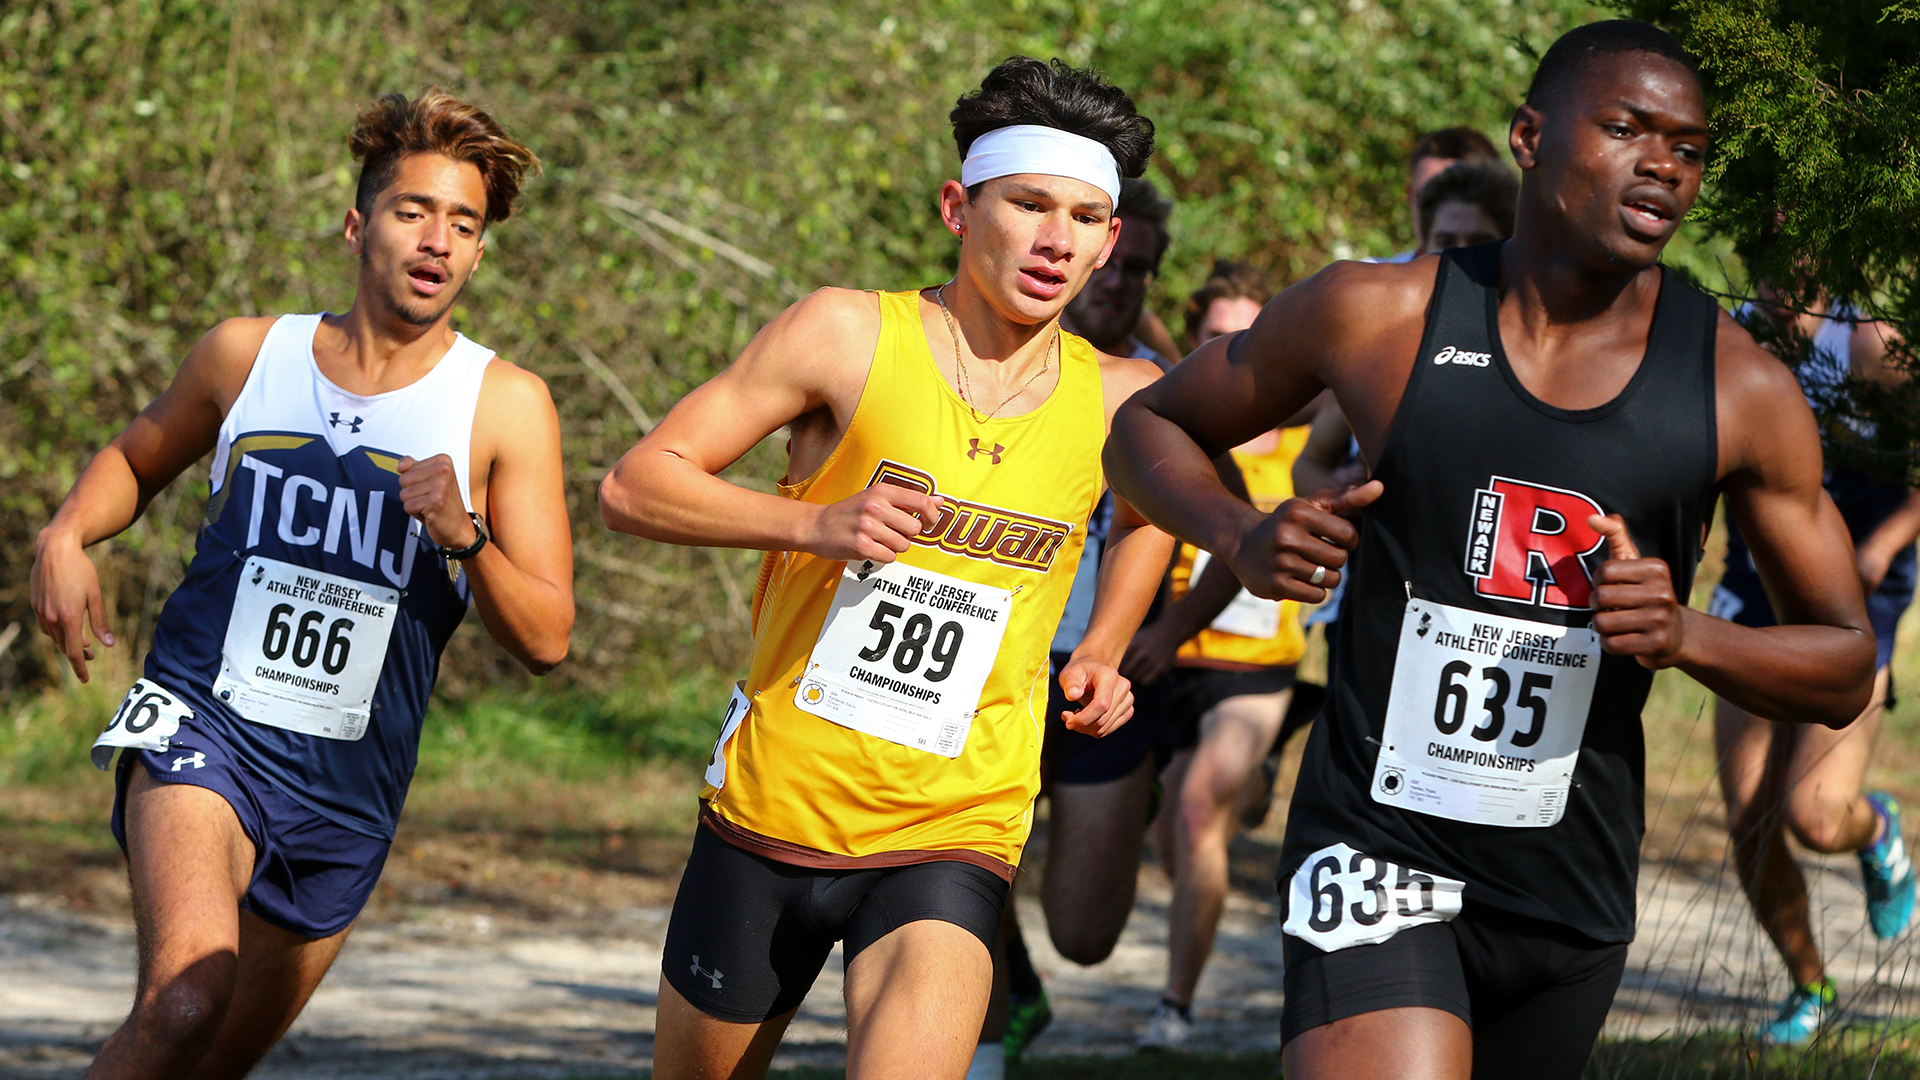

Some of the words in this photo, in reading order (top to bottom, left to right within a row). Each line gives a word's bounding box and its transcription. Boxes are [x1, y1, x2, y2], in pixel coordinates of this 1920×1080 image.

[1452, 349, 1491, 367] asics
[241, 453, 423, 589] TCNJ
[1469, 495, 1497, 574] NEWARK
[1474, 474, 1606, 611] R
[266, 580, 316, 602] ATHLETIC
[318, 593, 386, 618] CONFERENCE
[296, 575, 320, 591] NEW
[322, 582, 362, 601] JERSEY
[872, 578, 928, 604] ATHLETIC
[929, 595, 999, 622] CONFERENCE
[906, 575, 934, 593] NEW
[935, 584, 977, 604] JERSEY
[262, 603, 355, 676] 666
[858, 600, 964, 683] 589
[1435, 631, 1498, 656] ATHLETIC
[1502, 644, 1588, 668] CONFERENCE
[1472, 623, 1503, 641] NEW
[1506, 630, 1559, 650] JERSEY
[255, 665, 340, 696] CHAMPIONSHIPS
[849, 666, 942, 705] CHAMPIONSHIPS
[1434, 660, 1553, 748] 635
[1427, 742, 1536, 773] CHAMPIONSHIPS
